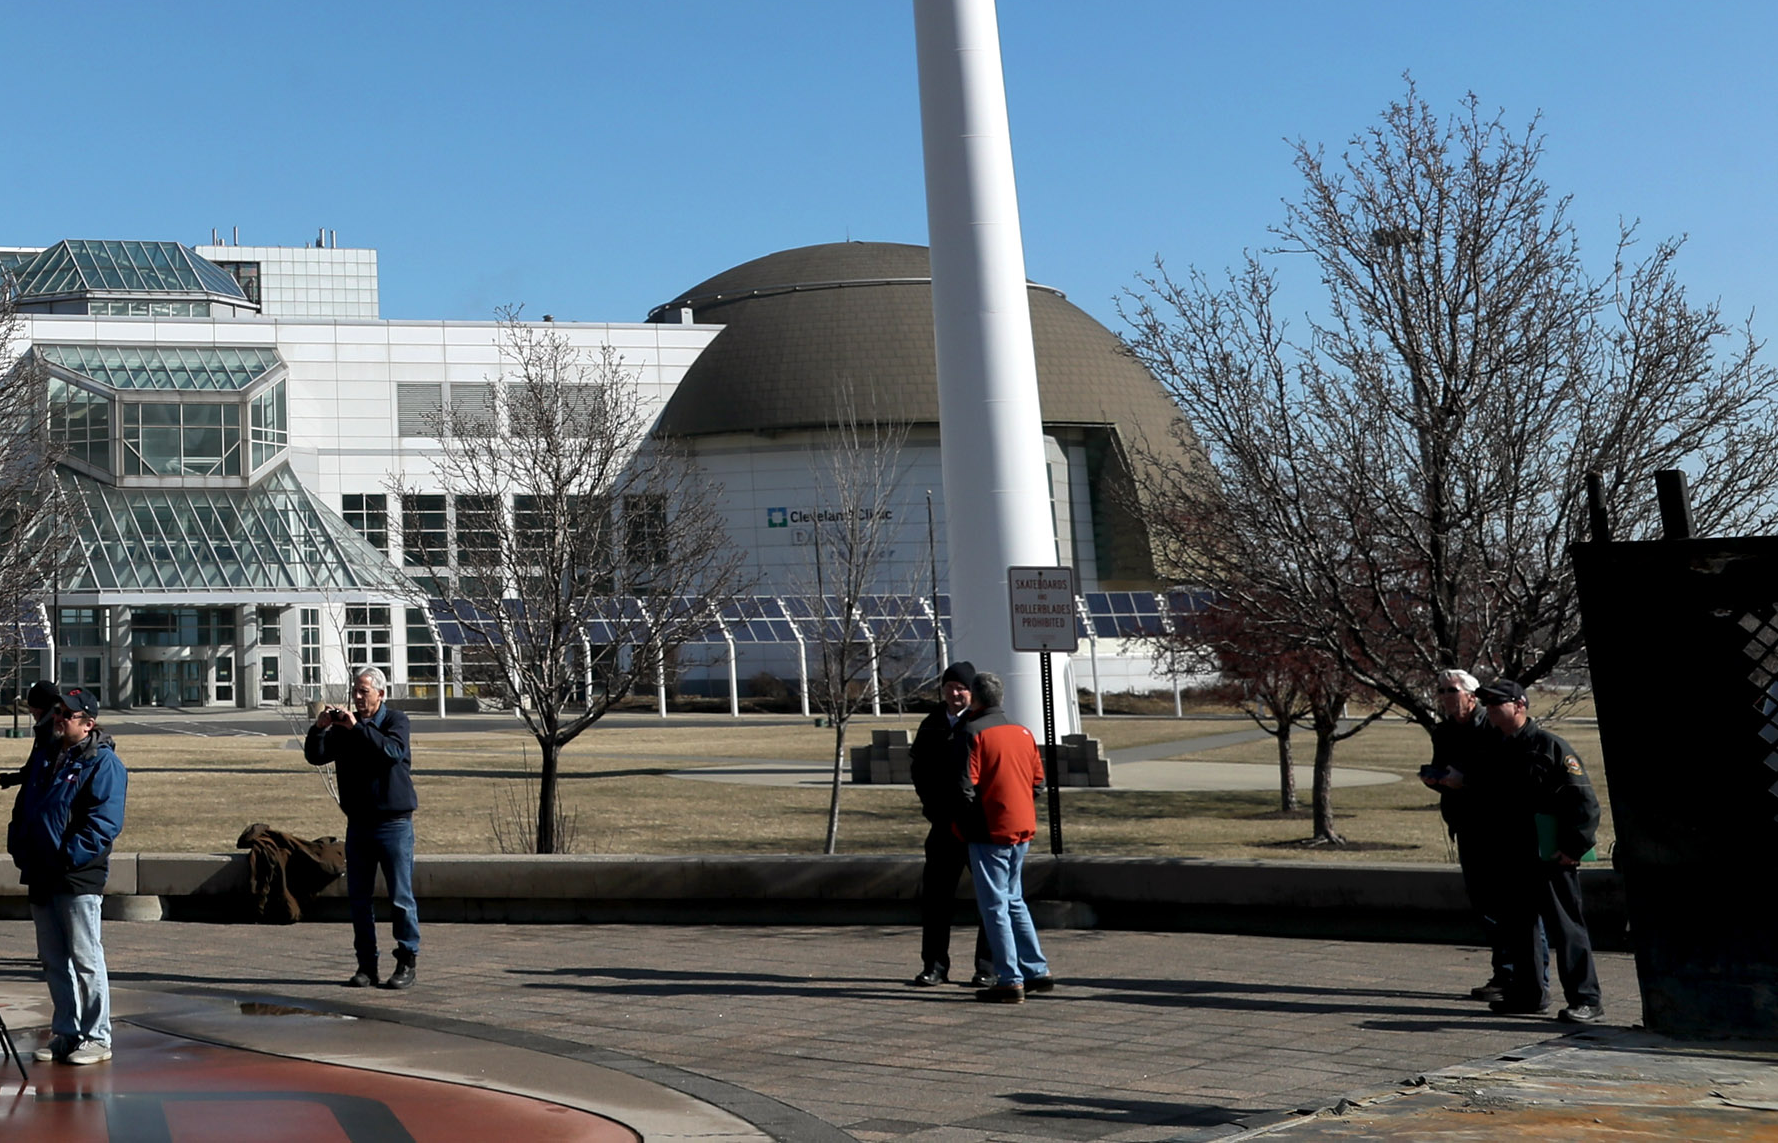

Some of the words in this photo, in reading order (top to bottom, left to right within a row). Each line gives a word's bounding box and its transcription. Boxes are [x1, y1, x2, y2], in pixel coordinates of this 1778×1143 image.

[1015, 579, 1068, 590] SKATEBOARDS
[1014, 604, 1071, 614] ROLLERBLADES
[1022, 618, 1066, 628] PROHIBITED
